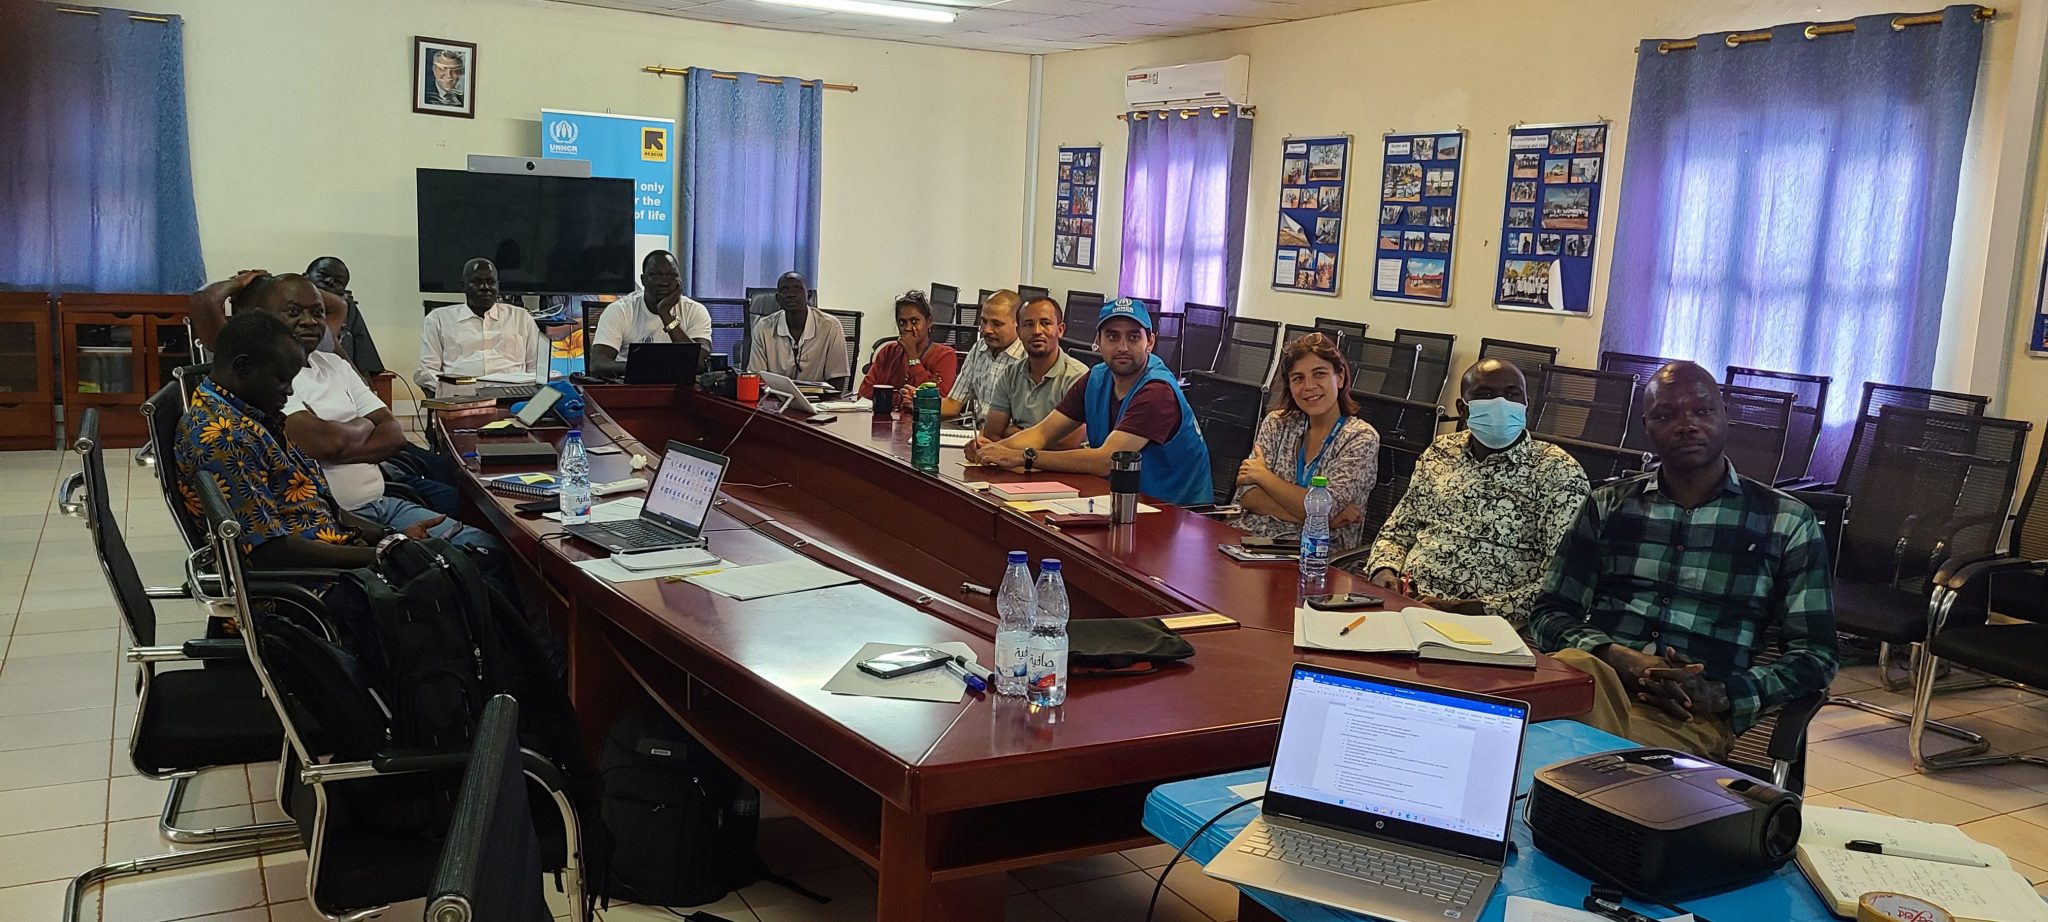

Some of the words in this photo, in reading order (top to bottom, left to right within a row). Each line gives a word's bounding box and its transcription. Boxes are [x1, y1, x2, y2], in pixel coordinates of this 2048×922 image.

[549, 143, 578, 153] UNHCR
[640, 182, 665, 195] only
[642, 195, 661, 206] the
[635, 210, 645, 220] of
[648, 210, 667, 221] life
